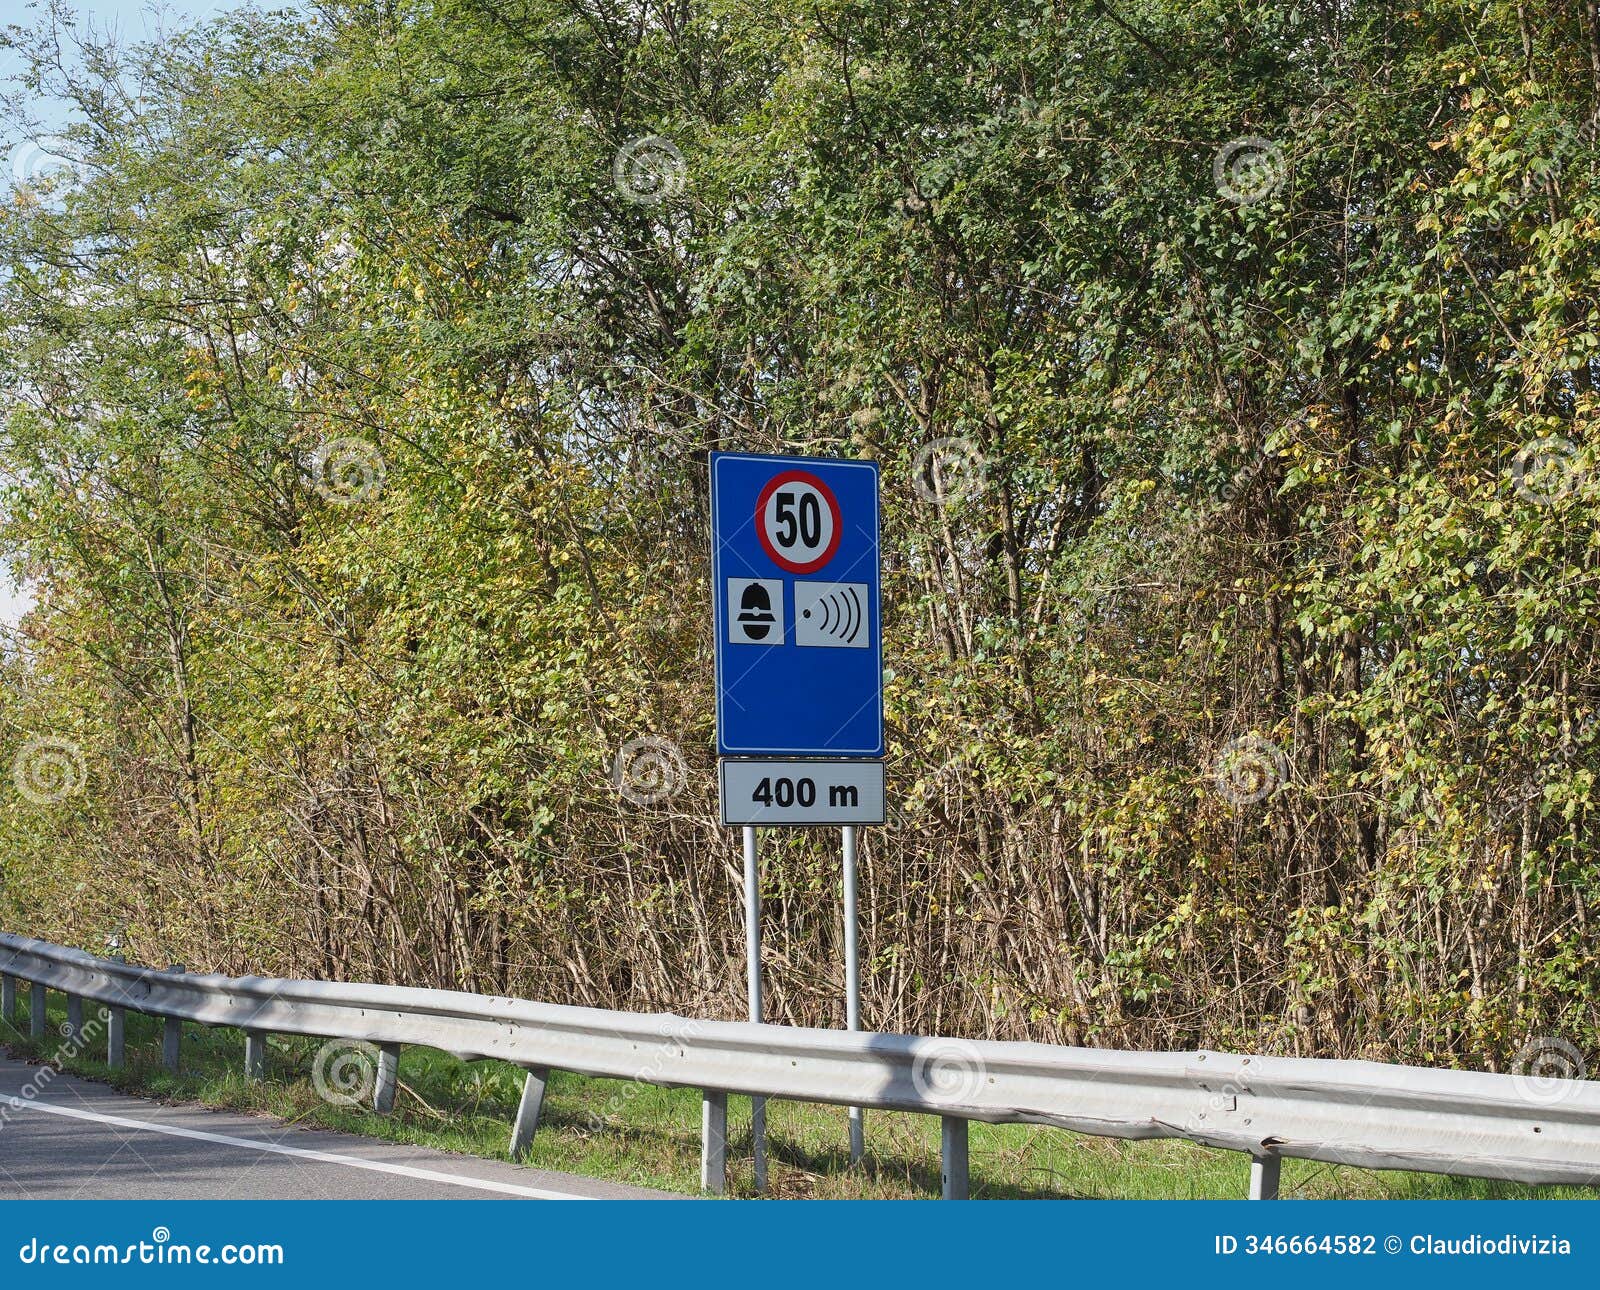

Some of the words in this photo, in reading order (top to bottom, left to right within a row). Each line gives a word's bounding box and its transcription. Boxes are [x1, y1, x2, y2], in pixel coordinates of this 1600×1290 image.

[775, 492, 822, 549] 50
[752, 777, 816, 808] 400
[829, 785, 859, 808] m
